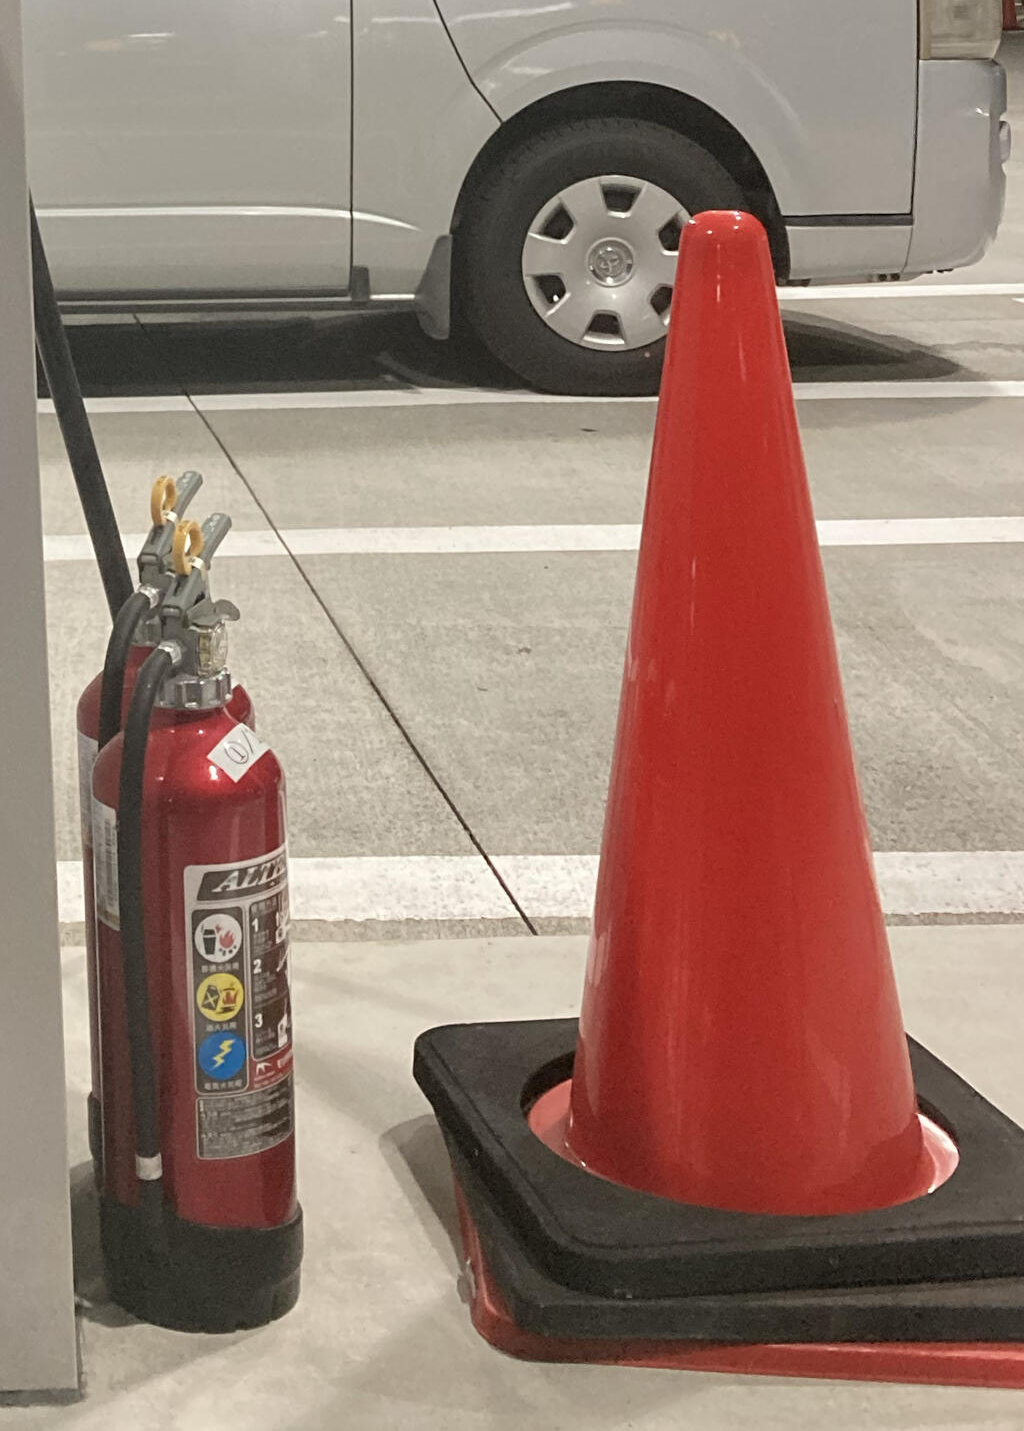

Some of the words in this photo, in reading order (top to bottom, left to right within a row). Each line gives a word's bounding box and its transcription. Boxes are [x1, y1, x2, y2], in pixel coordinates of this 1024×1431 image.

[252, 918, 259, 932] 1
[253, 959, 262, 974] 2
[254, 1013, 263, 1028] 3
